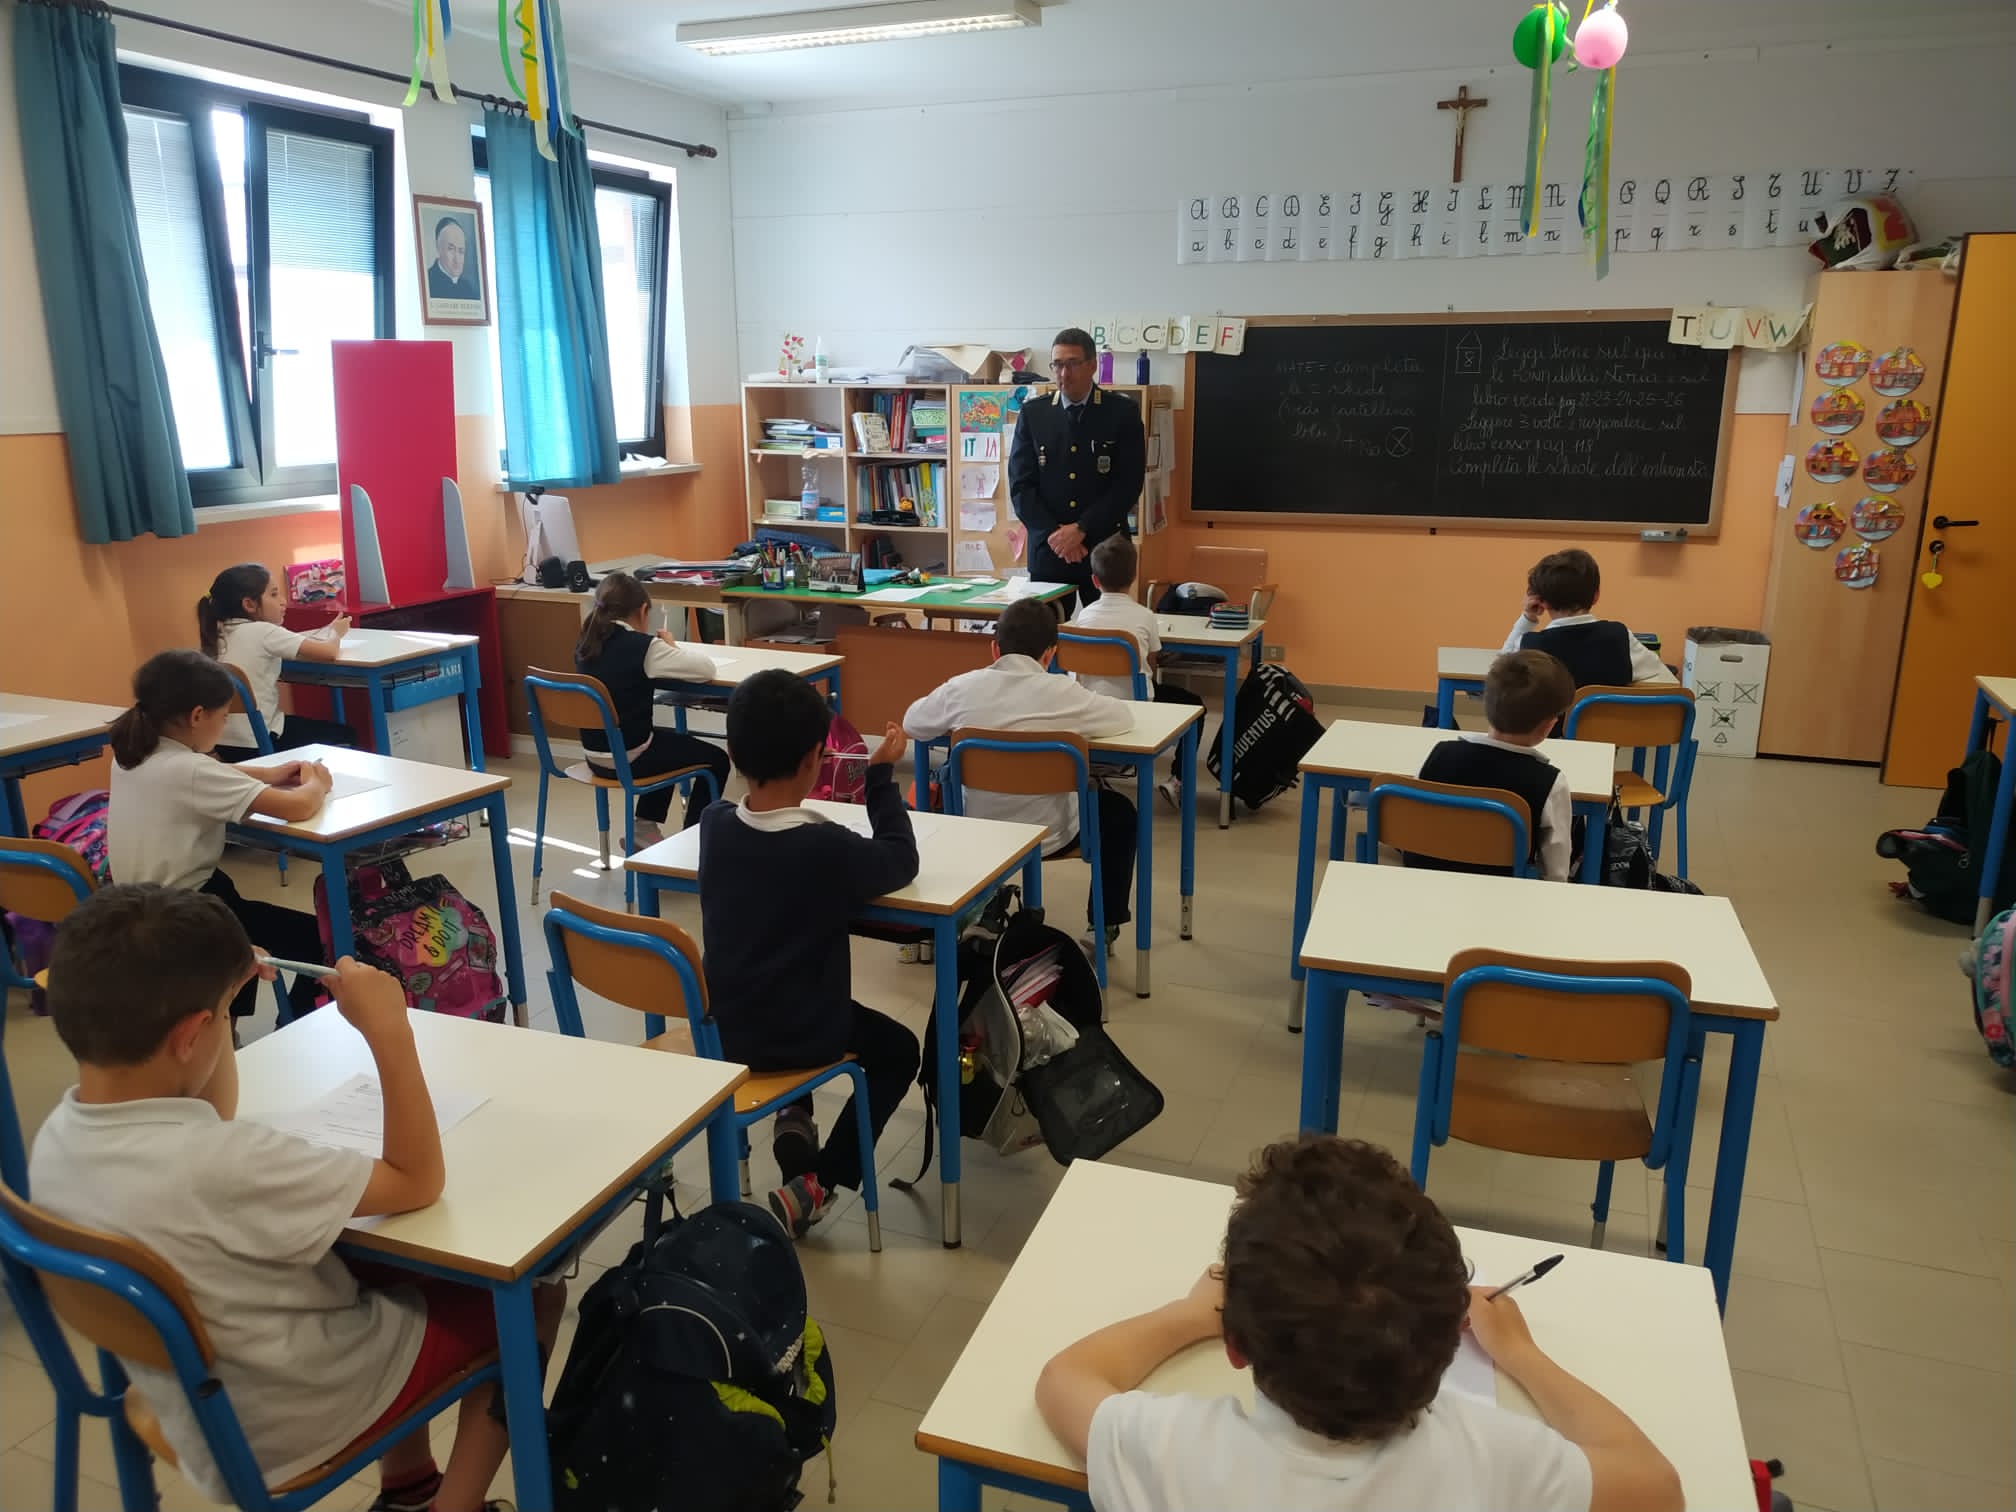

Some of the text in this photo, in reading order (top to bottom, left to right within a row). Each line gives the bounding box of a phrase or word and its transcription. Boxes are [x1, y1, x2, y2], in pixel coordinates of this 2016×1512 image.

[1191, 199, 1209, 220] A
[1222, 197, 1240, 218] B
[1256, 195, 1269, 217] C
[1318, 193, 1330, 216] E
[1378, 192, 1395, 225] G
[1412, 190, 1429, 213] H
[1478, 187, 1493, 210] L
[1545, 184, 1567, 207] N
[1620, 181, 1636, 204] P
[1655, 179, 1670, 204] Q
[1687, 177, 1710, 201] R
[1802, 170, 1823, 196] U
[1846, 170, 1863, 193] V
[1192, 209, 1808, 259] a b c d e f g h i l m n p q r s t u
[1093, 326, 1106, 345] B
[1143, 325, 1161, 343] C
[1170, 326, 1185, 346] D
[1196, 325, 1210, 345] E
[1221, 327, 1234, 347] F
[1677, 315, 1696, 337] T
[1710, 319, 1732, 340] U
[1746, 318, 1761, 339] V
[1233, 708, 1277, 764] UVENTUS
